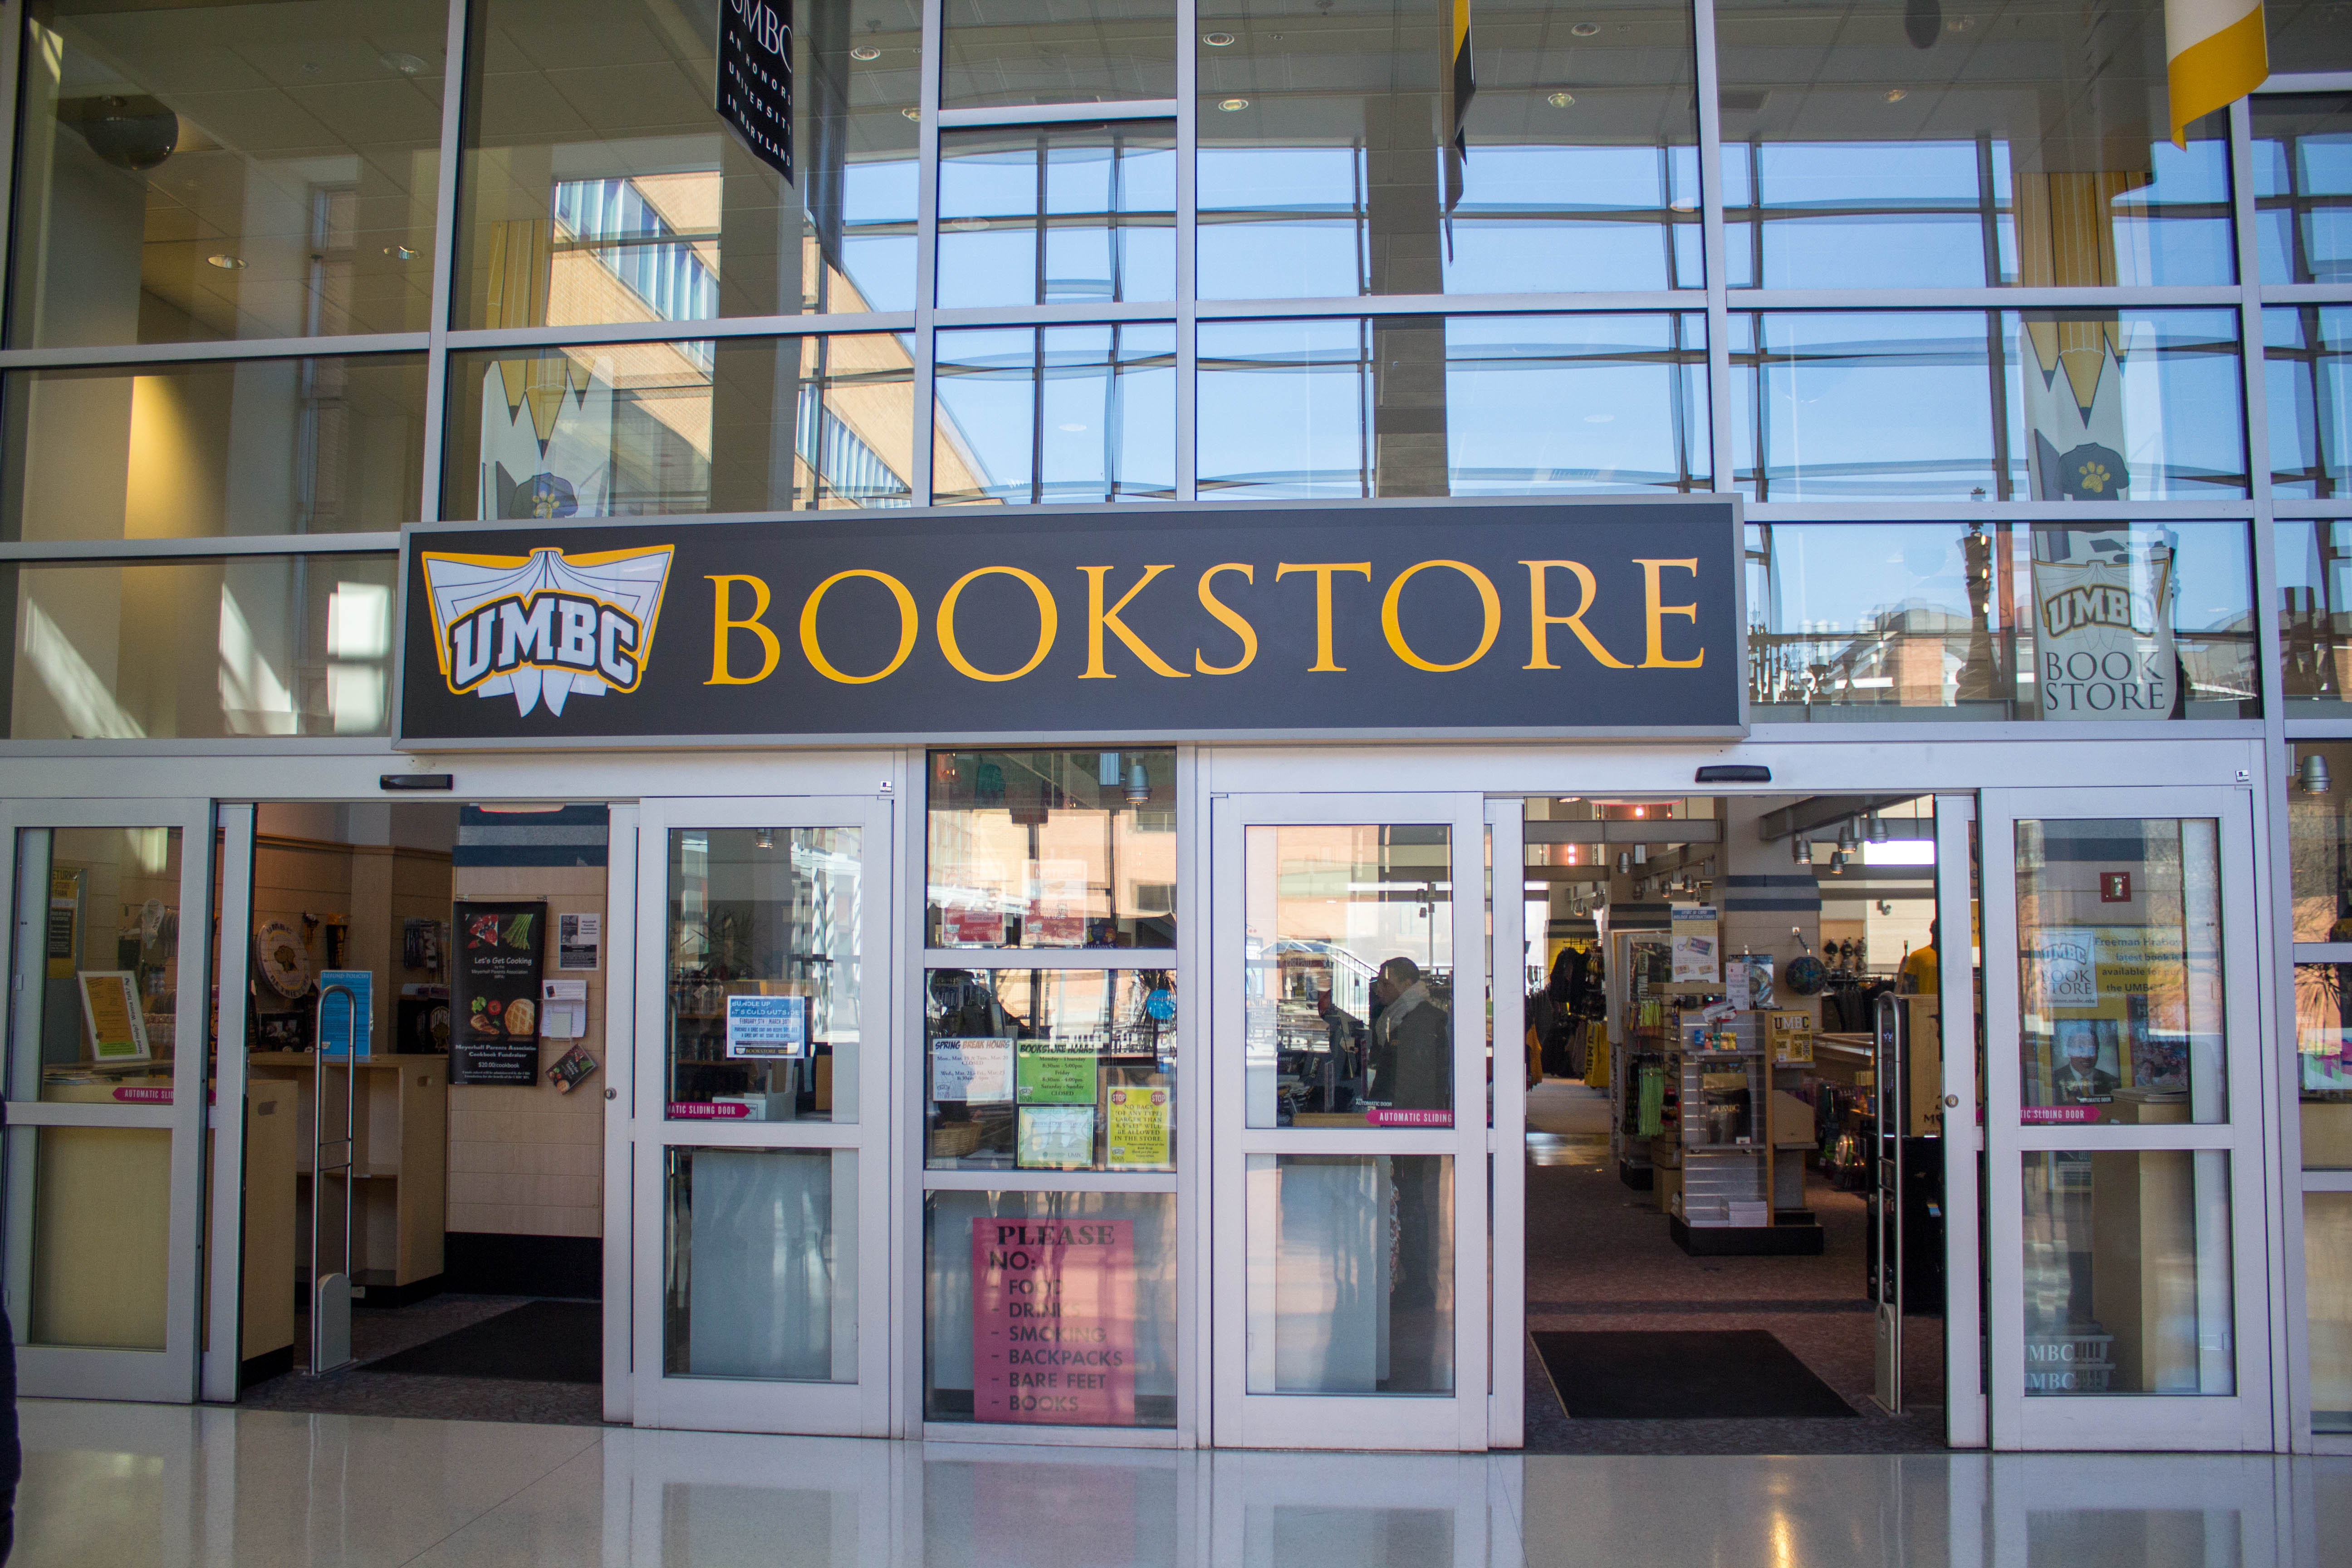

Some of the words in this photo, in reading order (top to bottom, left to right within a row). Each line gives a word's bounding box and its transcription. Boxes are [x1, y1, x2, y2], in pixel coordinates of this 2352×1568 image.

[729, 30, 741, 52] AN
[746, 53, 791, 106] HONORS
[729, 61, 791, 136] UNIVERSITY
[727, 94, 737, 112] IN
[740, 111, 790, 167] MARYLAND
[453, 598, 633, 686] UMBC
[704, 558, 1704, 685] BOOKSTORE
[2044, 651, 2166, 681] BOOK
[2046, 682, 2166, 711] STORE
[1035, 868, 1075, 877] NOTICE
[2094, 937, 2140, 946] Freeman
[506, 957, 532, 965] Cooking
[2043, 944, 2086, 965] UMBC
[2116, 952, 2142, 961] latest
[2144, 952, 2170, 961] book
[2042, 970, 2091, 982] BOOK
[2102, 967, 2145, 976] available
[2042, 983, 2092, 995] STORE
[2107, 984, 2122, 992] the
[2125, 983, 2157, 992] UMBC
[1774, 1016, 1809, 1029] UMBC
[132, 1024, 141, 1039] Help?
[935, 1040, 961, 1050] SPRING
[962, 1040, 985, 1049] BREAK
[986, 1040, 1010, 1049] HOURS
[1020, 1044, 1066, 1054] BOOKSTORE
[1068, 1044, 1094, 1053] HOURS
[124, 1089, 158, 1098] AUTOMATIC
[689, 1106, 715, 1115] SLIDING
[718, 1106, 735, 1115] DOOR
[1380, 1112, 1420, 1122] AUTOMATIC
[1424, 1113, 1452, 1122] SLIDING
[2034, 1110, 2062, 1119] SLIDING
[2065, 1110, 2084, 1119] DOOR
[996, 1225, 1116, 1246] PLEASE
[990, 1251, 1036, 1271] NO:
[1009, 1280, 1064, 1295] FOOD
[1009, 1303, 1079, 1318] DRINKS
[1009, 1326, 1106, 1343] SMOKING
[1009, 1349, 1123, 1367] BACKPACKS
[2025, 1344, 2073, 1362] MBC
[1009, 1373, 1057, 1388] BARE
[1067, 1374, 1106, 1389] FEET
[2025, 1372, 2074, 1390] MBC
[1009, 1395, 1079, 1412] BOOKS
